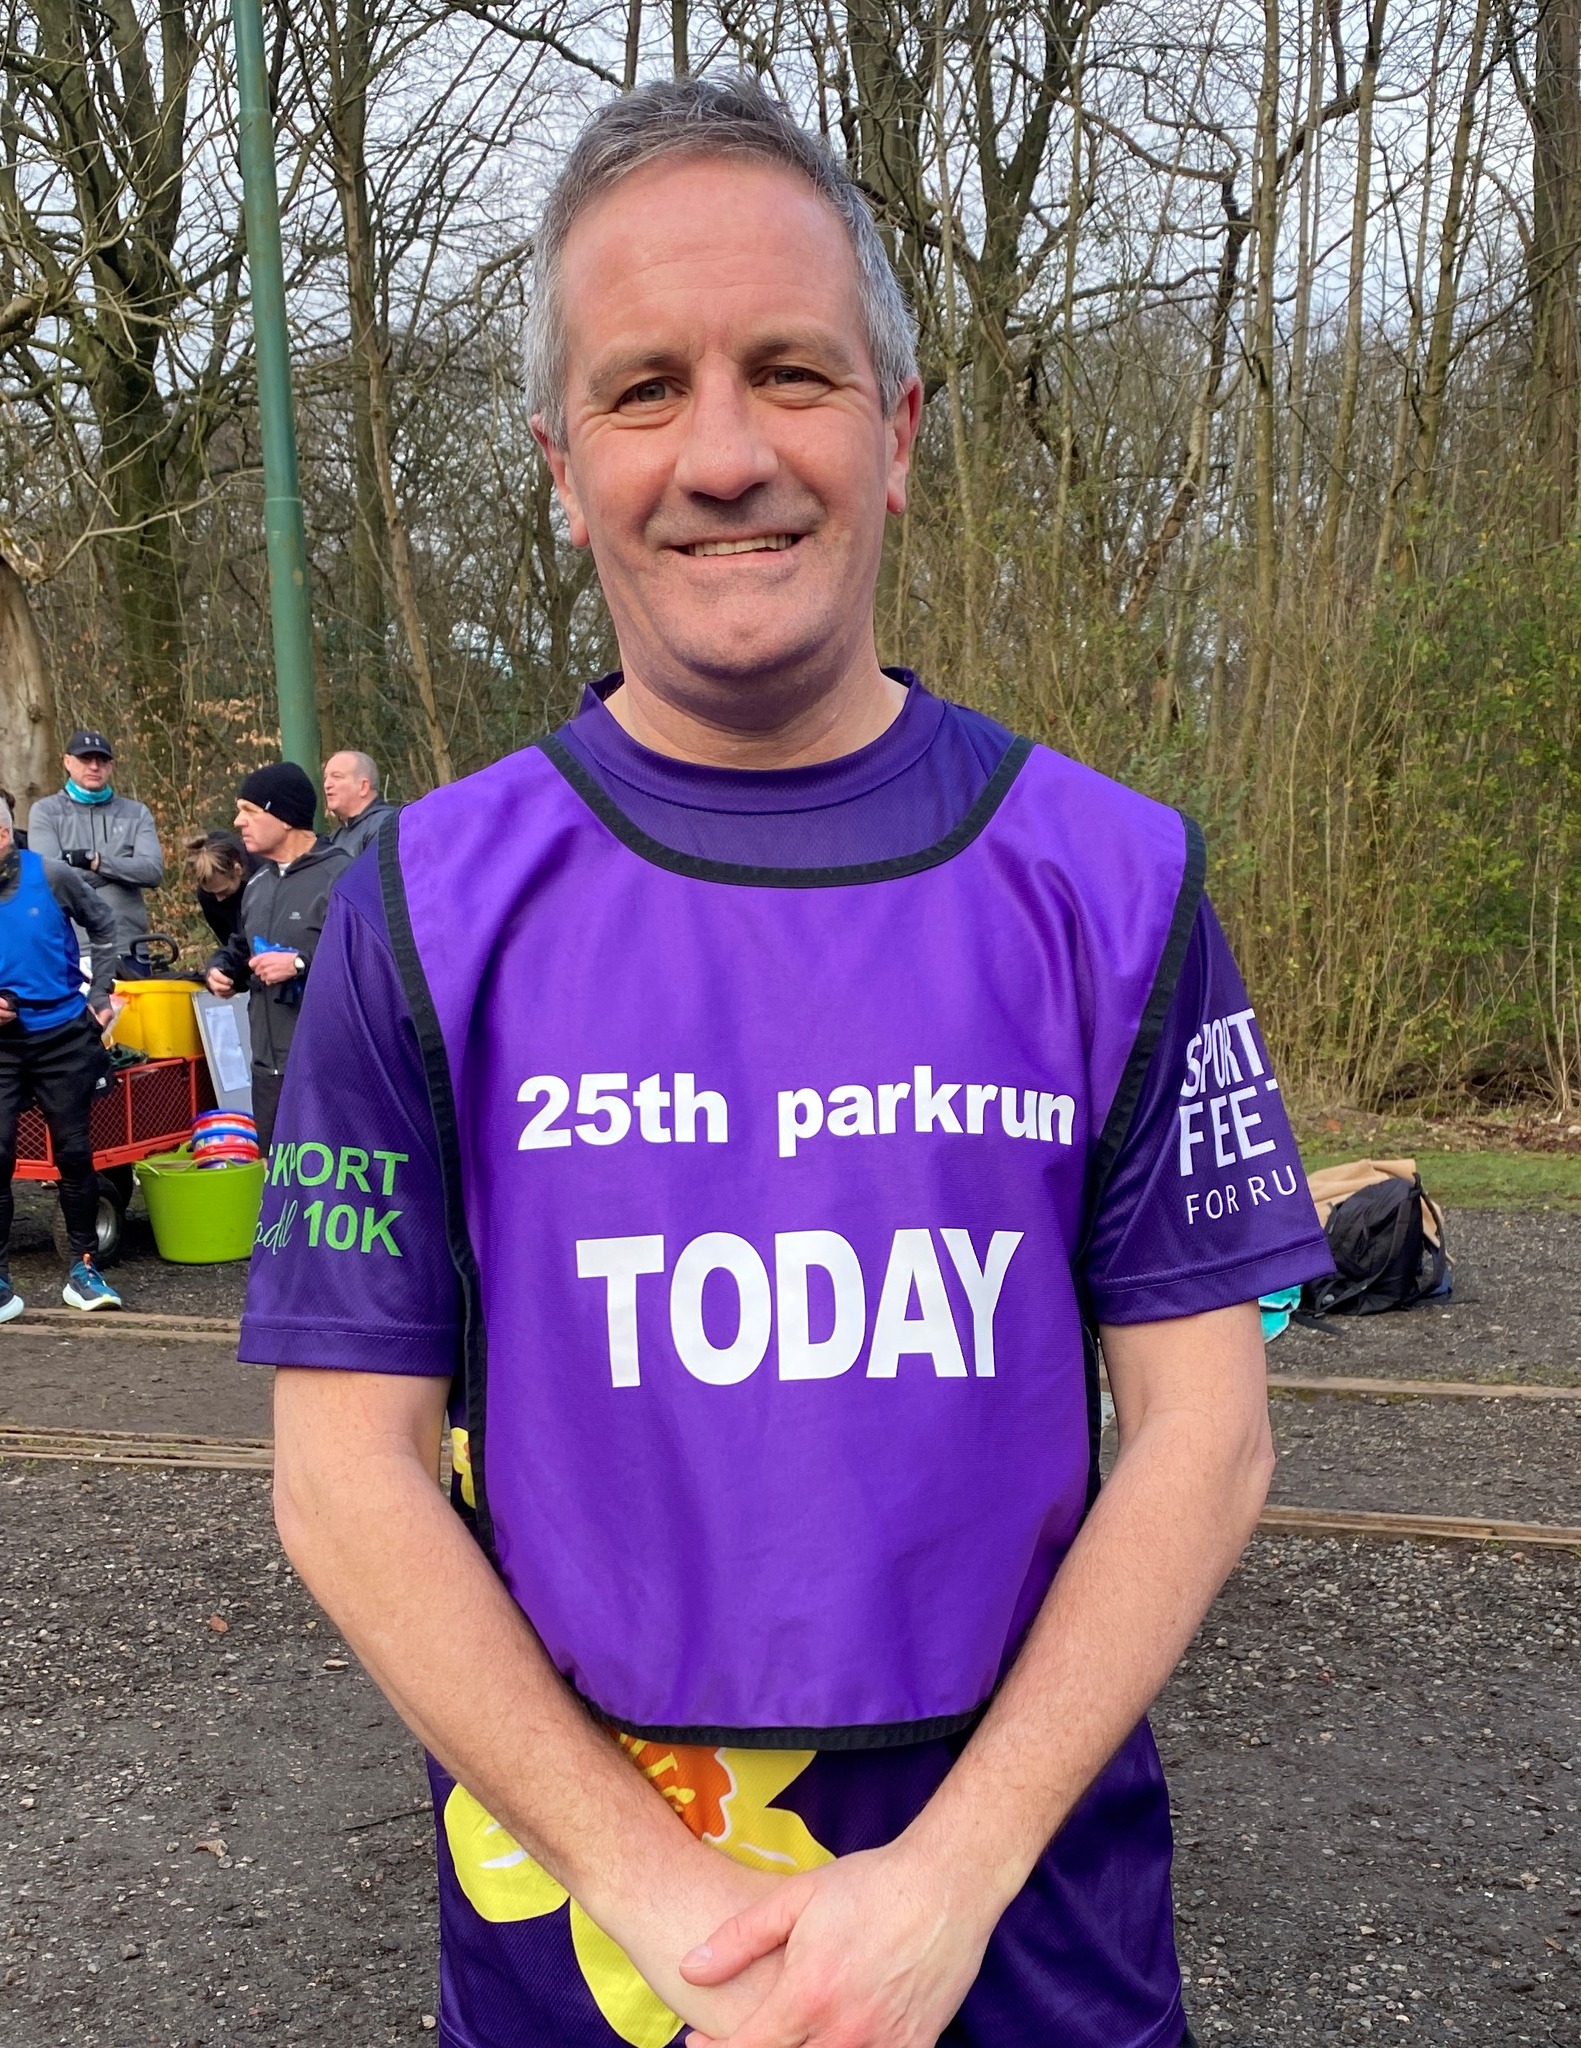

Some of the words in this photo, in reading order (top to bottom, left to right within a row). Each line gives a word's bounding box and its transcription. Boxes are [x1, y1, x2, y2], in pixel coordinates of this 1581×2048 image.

[1180, 1007, 1265, 1098] SPORT
[516, 1072, 729, 1151] 25th
[777, 1065, 1076, 1158] parkrun
[1178, 1078, 1279, 1177] FEE
[264, 1142, 409, 1196] KPORT
[1185, 1184, 1240, 1225] FOR
[1247, 1164, 1298, 1206] RU
[303, 1200, 403, 1257] 10K
[575, 1228, 1025, 1388] TODAY
